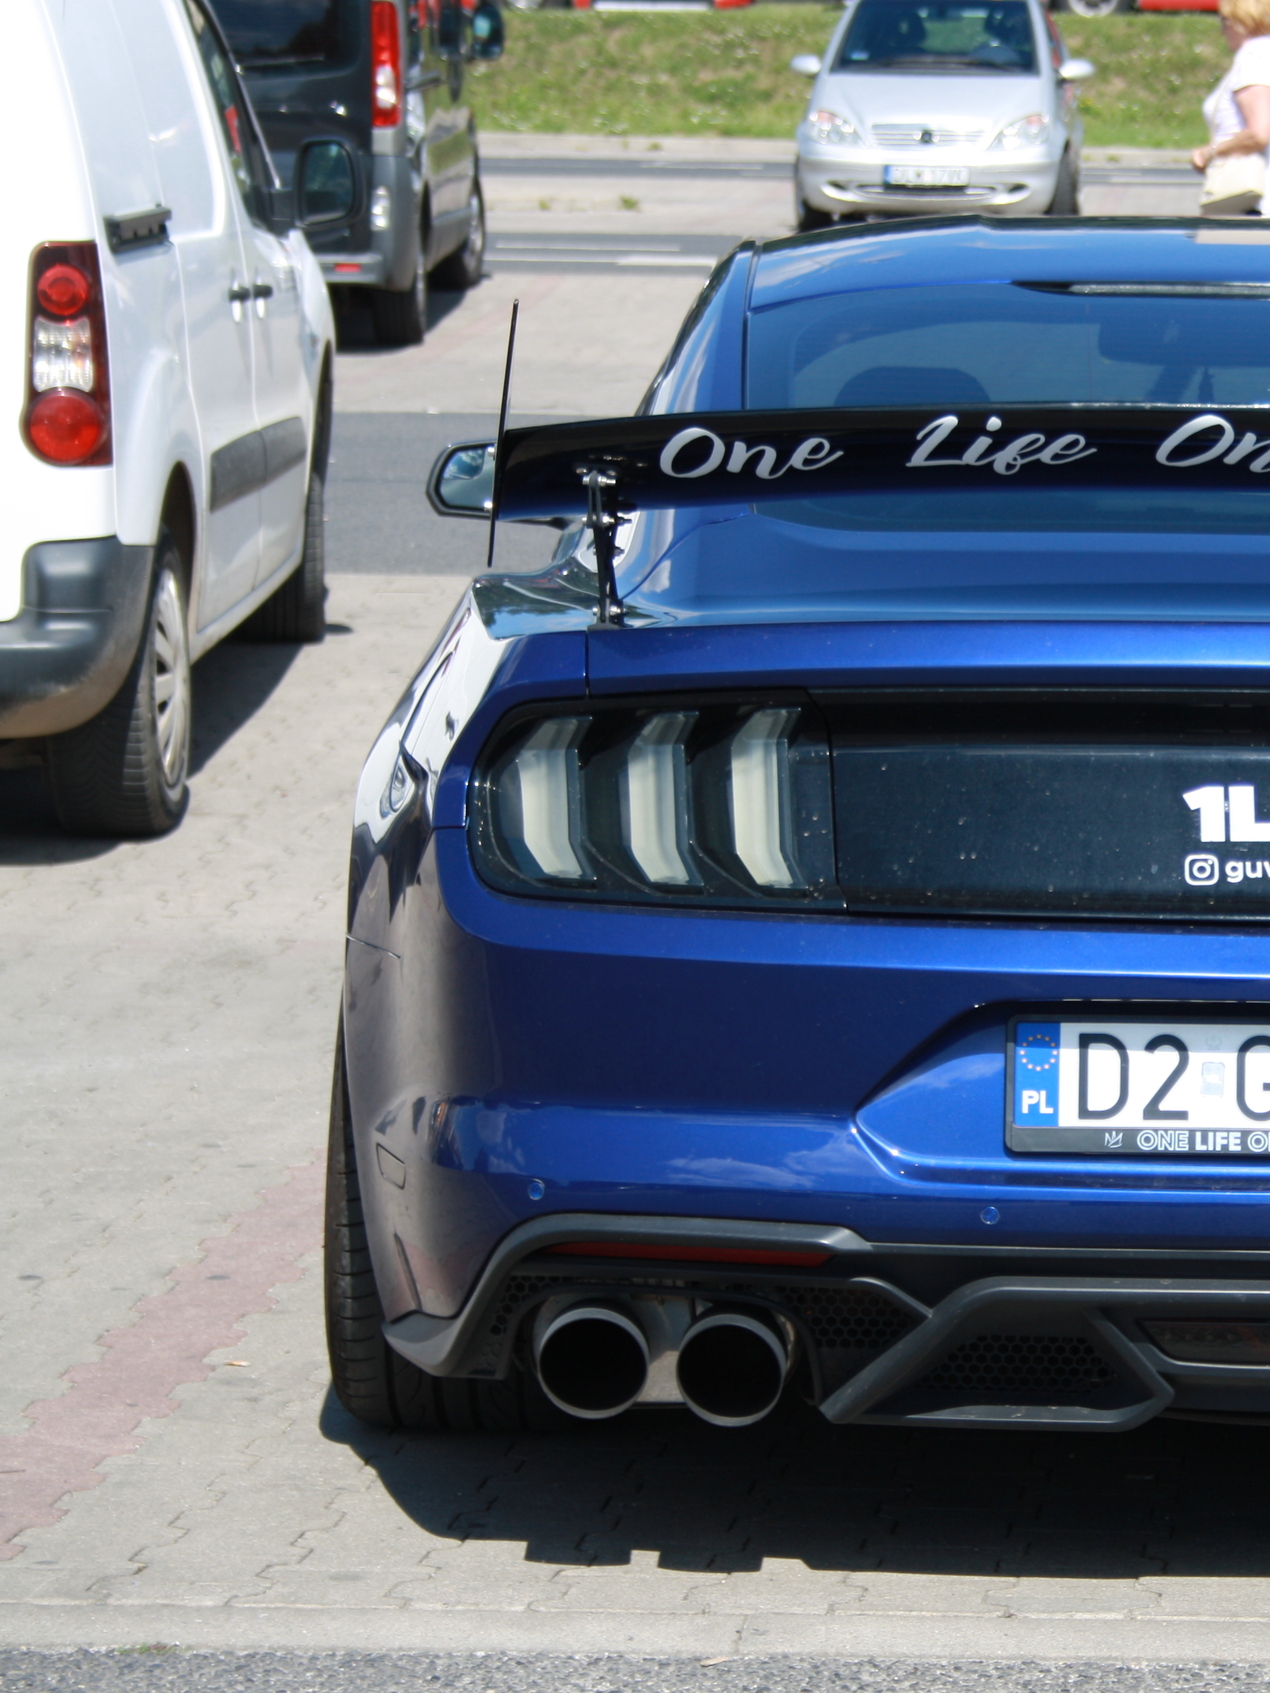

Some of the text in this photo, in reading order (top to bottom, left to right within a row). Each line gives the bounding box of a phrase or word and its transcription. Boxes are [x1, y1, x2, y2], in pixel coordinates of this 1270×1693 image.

[660, 426, 844, 480] One
[905, 415, 1098, 475] Life
[1077, 1032, 1190, 1121] D2
[1021, 1090, 1054, 1114] PL
[1136, 1129, 1189, 1151] ONE
[1194, 1131, 1242, 1151] LIFE
